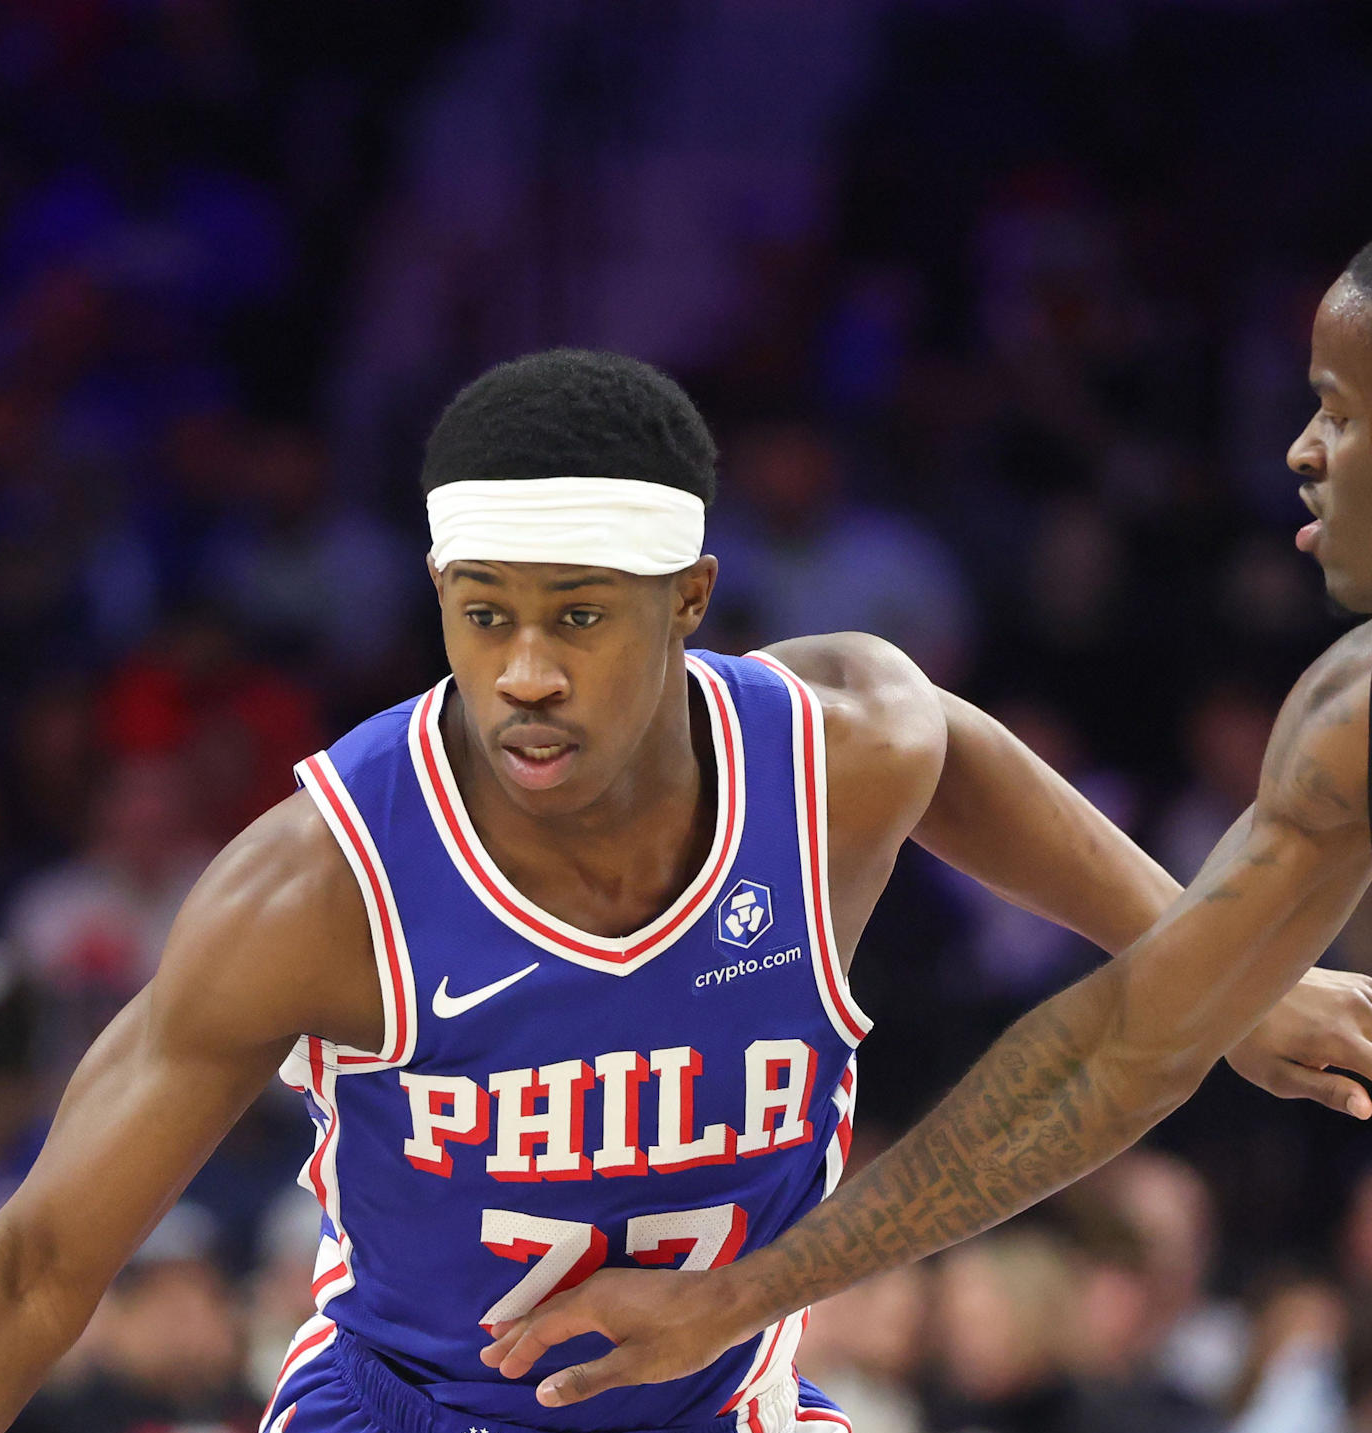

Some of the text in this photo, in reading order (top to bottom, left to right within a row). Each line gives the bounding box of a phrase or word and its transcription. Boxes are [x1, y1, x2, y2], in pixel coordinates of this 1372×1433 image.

[694, 946, 802, 988] crypto.com
[399, 1038, 819, 1183] PHILA
[479, 1203, 748, 1334] 77
